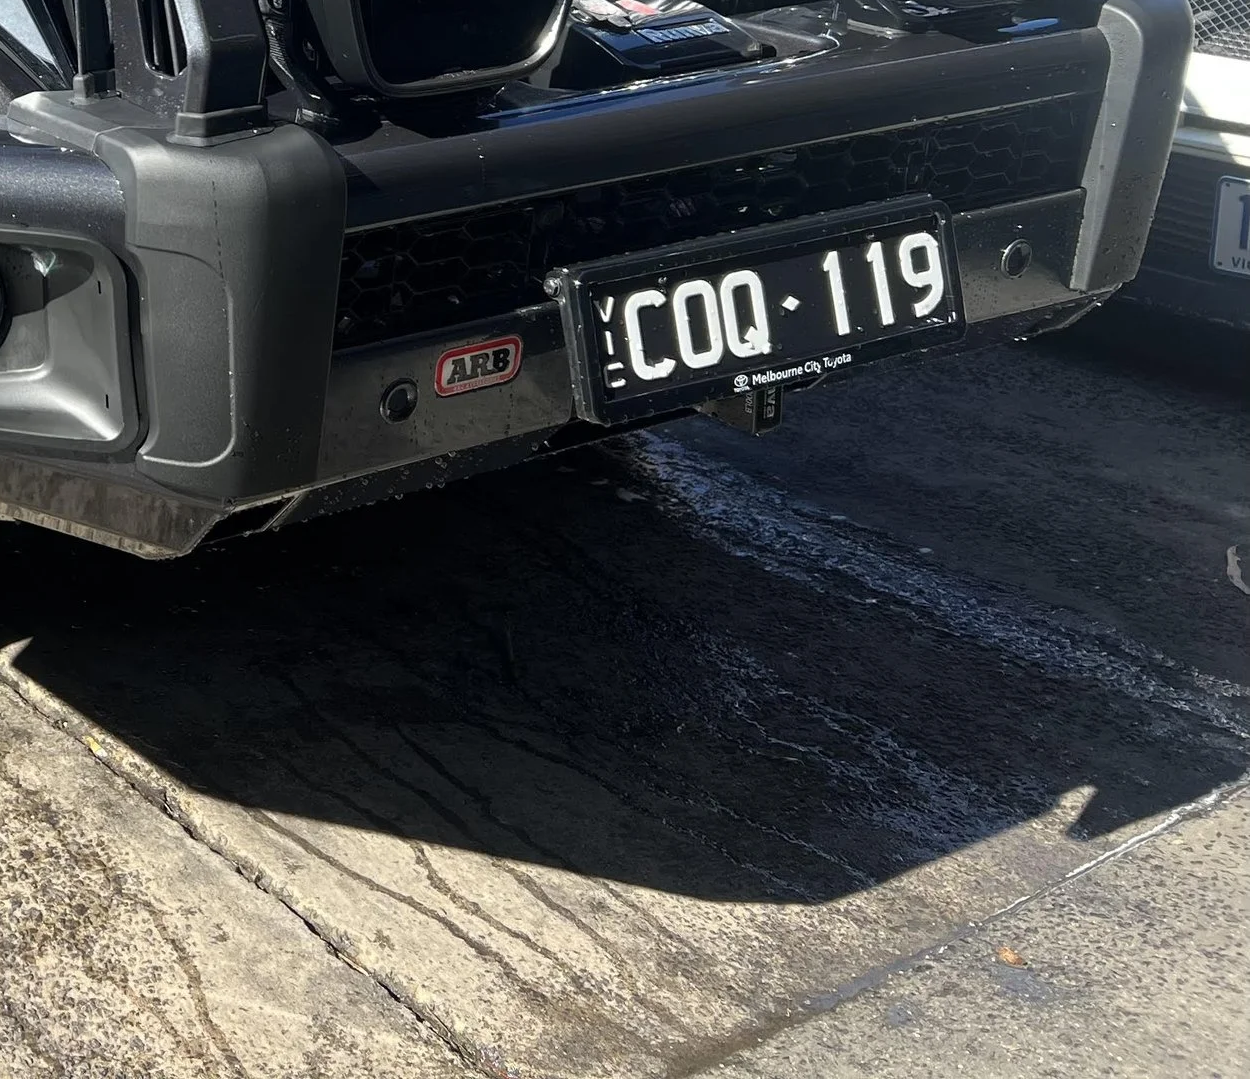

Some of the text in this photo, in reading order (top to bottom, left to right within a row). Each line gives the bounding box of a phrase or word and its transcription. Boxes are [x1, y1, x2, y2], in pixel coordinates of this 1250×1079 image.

[447, 348, 510, 385] ARB
[752, 353, 852, 385] Melbourne City Toyota
